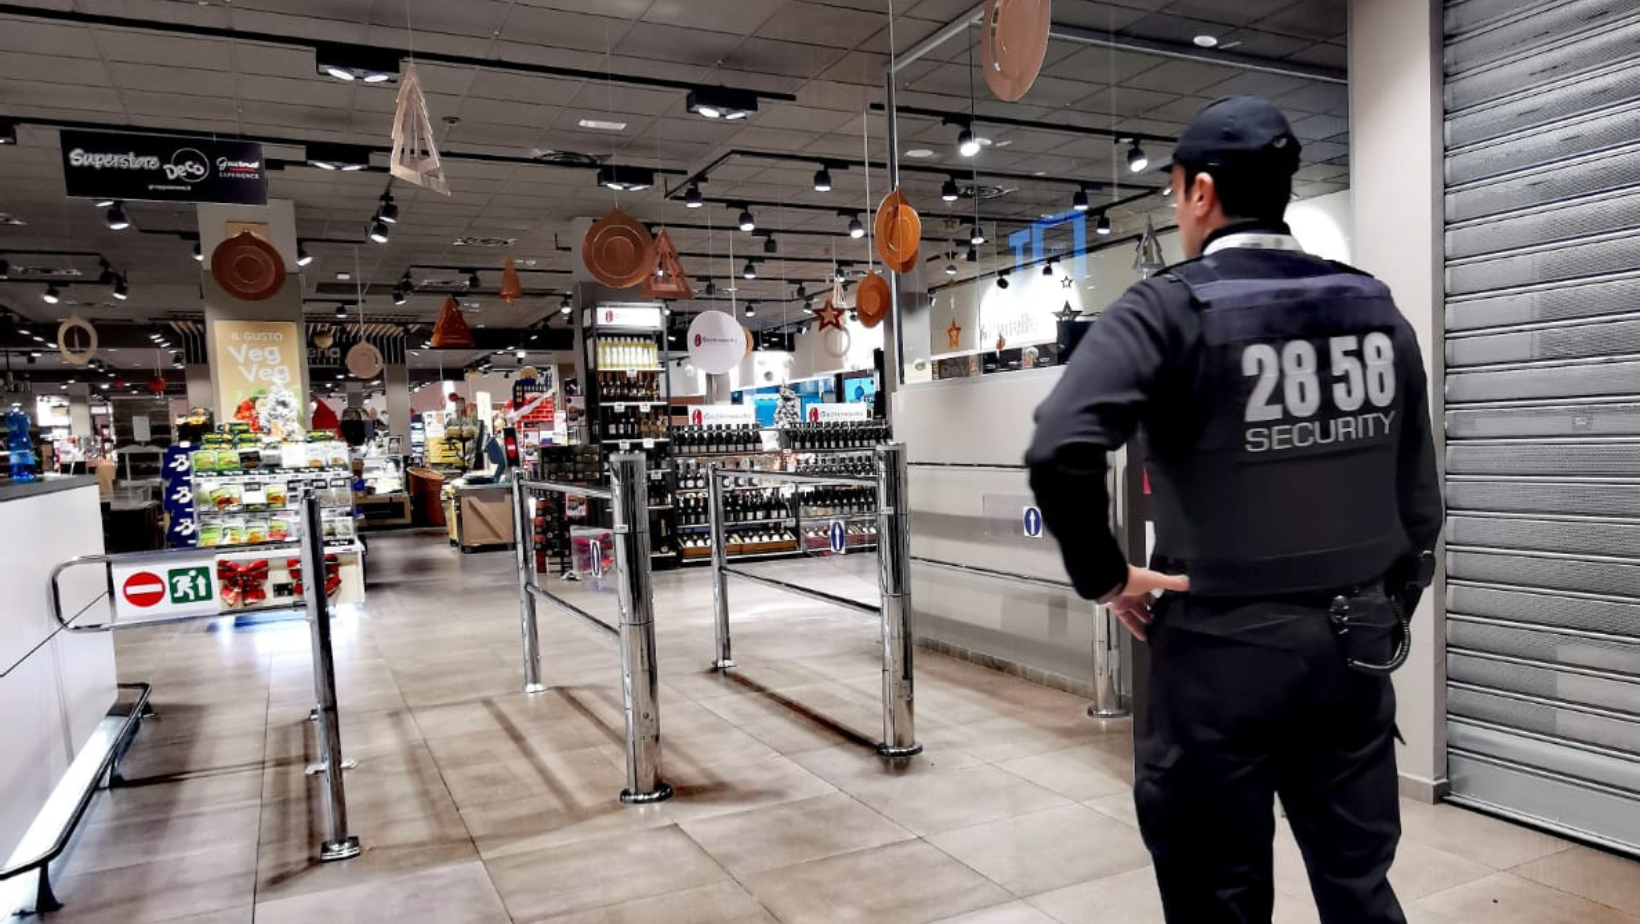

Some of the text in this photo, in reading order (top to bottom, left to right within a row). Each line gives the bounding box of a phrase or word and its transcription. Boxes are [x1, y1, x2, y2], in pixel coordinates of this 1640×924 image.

[69, 148, 160, 170] Superstore
[244, 332, 283, 341] GUSTO
[228, 345, 281, 364] Veg
[238, 364, 291, 382] Veg
[1242, 331, 1396, 422] 28 58
[1244, 410, 1396, 452] SECURITY
